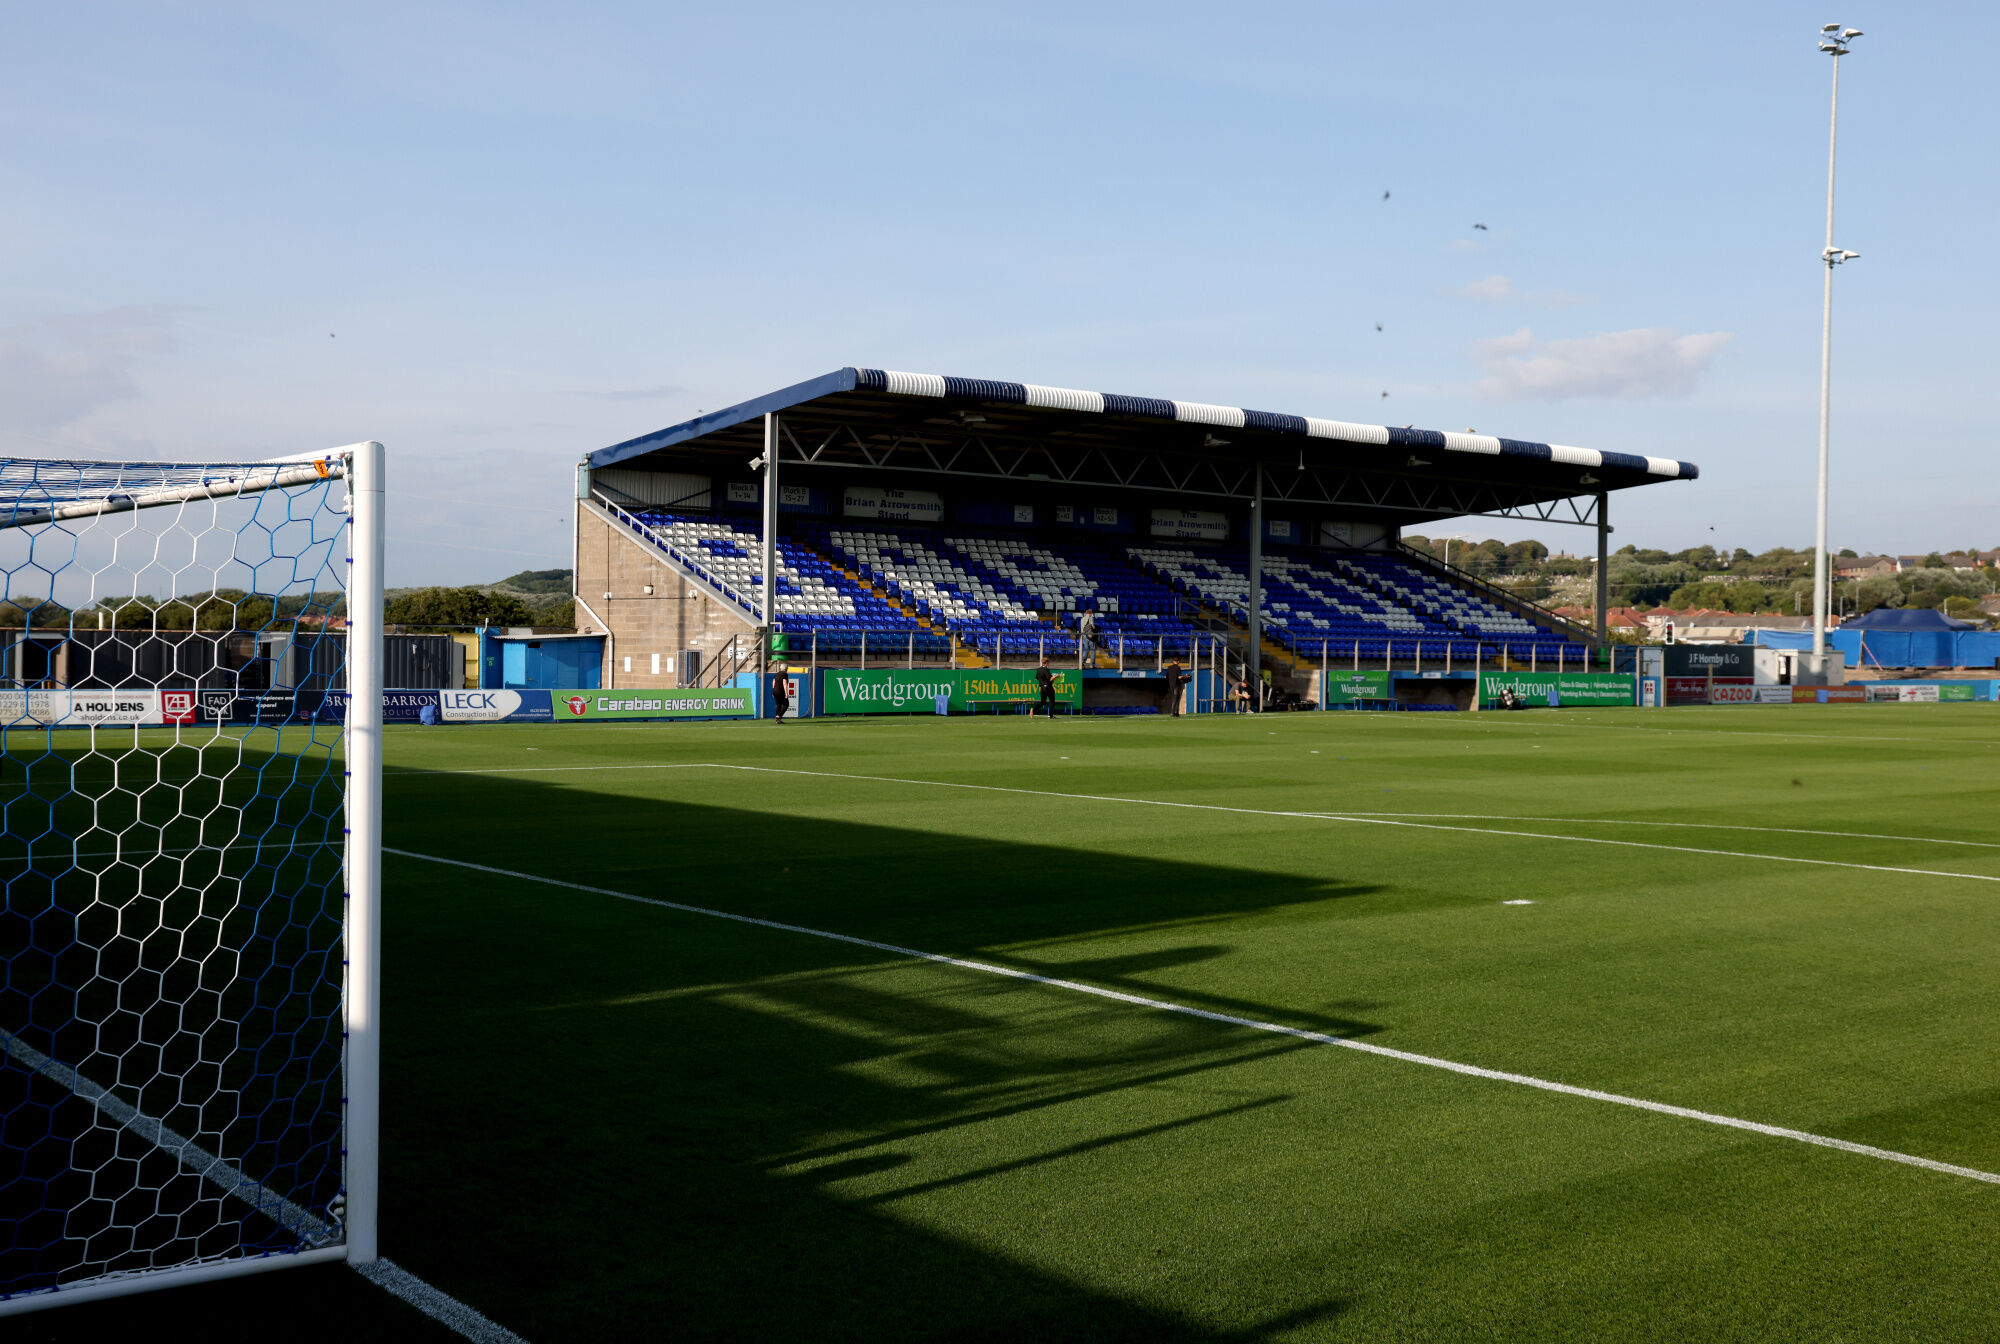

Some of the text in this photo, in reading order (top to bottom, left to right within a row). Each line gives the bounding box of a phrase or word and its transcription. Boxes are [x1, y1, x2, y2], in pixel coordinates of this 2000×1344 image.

[884, 488, 904, 497] The
[845, 497, 941, 511] Brian Arrowsmith
[878, 510, 909, 520] Stand
[1151, 518, 1226, 531] Brian Arrowsmith
[1176, 530, 1201, 539] Stand
[1699, 653, 1723, 666] Hornby
[1731, 653, 1740, 664] Co
[836, 676, 1077, 706] Wardgroup 150th Annivsary
[1341, 684, 1376, 696] Wardgroup
[1713, 688, 1752, 701] CAZOO
[208, 697, 227, 705] FAD
[383, 695, 438, 706] BARRON
[444, 693, 496, 709] LECK
[597, 696, 745, 712] Carabao ENERGY DRINK
[74, 702, 144, 712] A HOLDENS
[383, 708, 439, 716] SOLICITS
